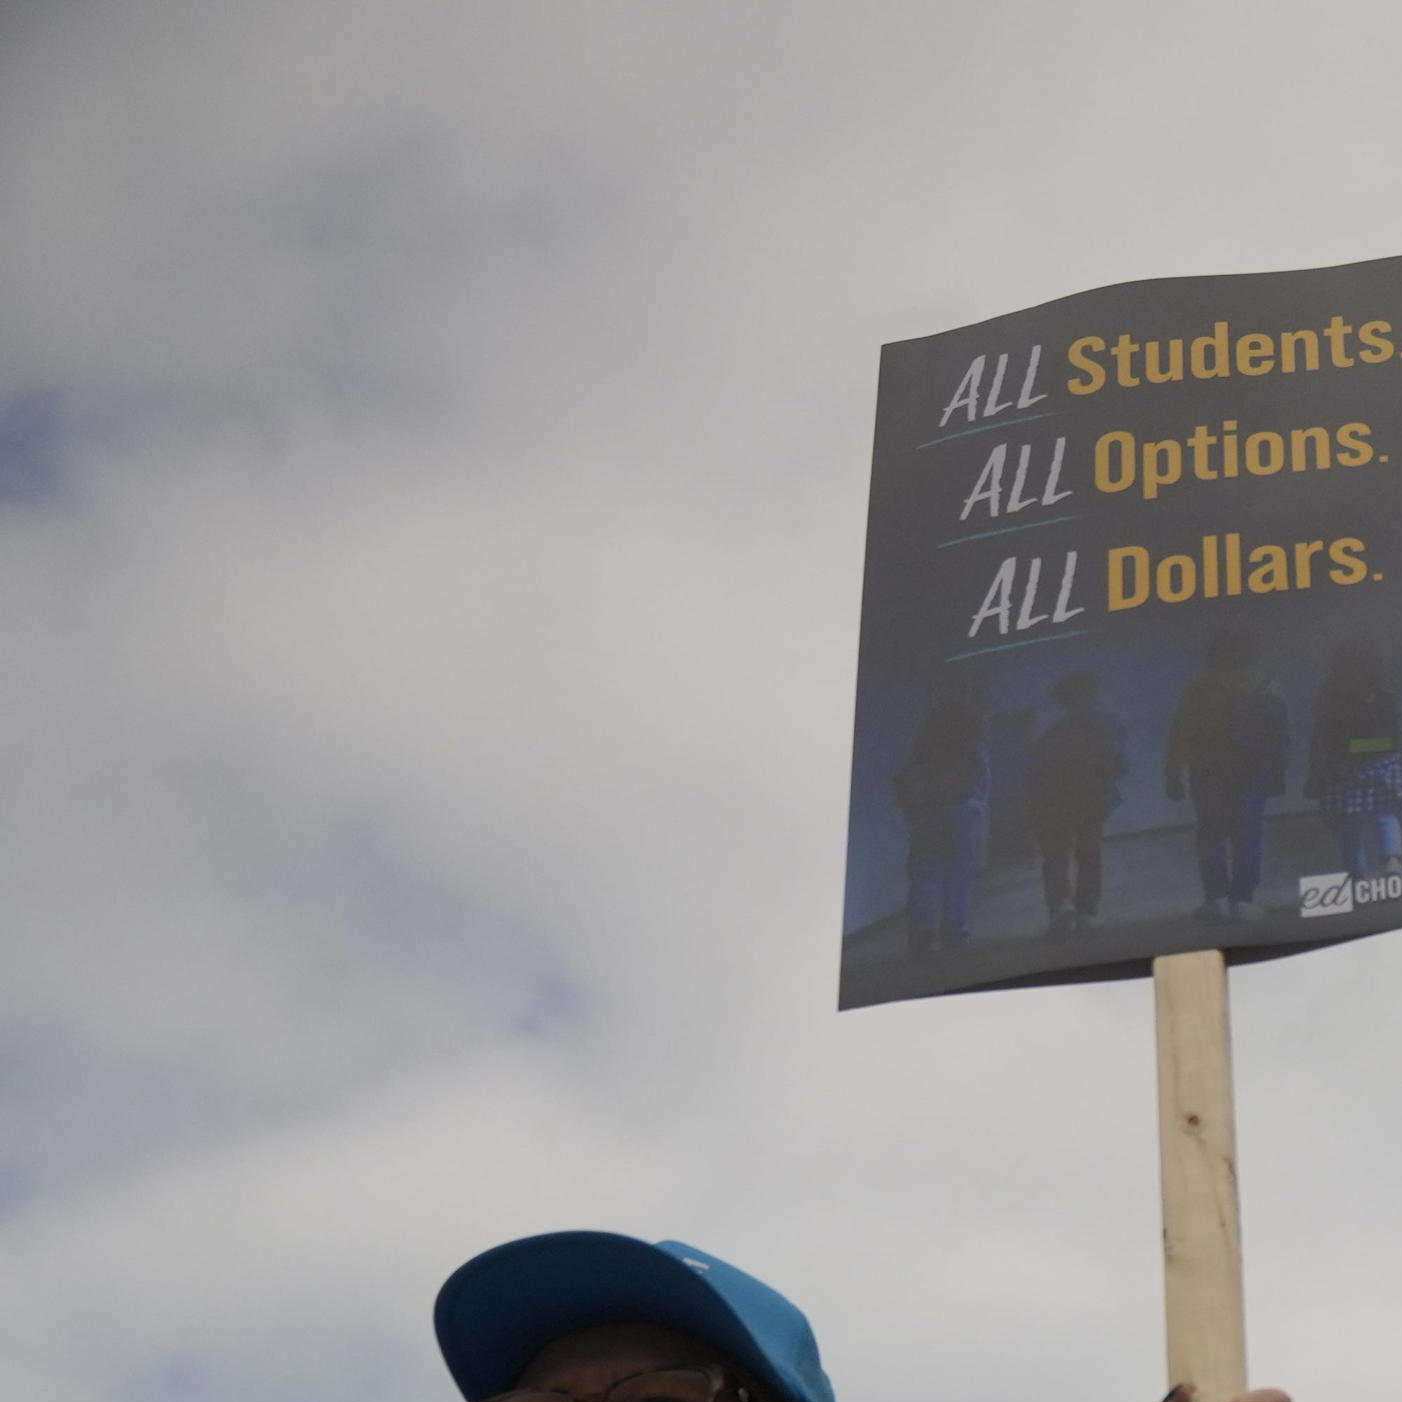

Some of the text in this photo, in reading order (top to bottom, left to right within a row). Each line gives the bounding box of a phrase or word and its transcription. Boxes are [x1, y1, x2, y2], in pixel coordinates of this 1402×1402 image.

[938, 345, 1047, 427] ALL
[959, 420, 1390, 520] ALL Options.
[968, 532, 1383, 638] ALL Dollars.
